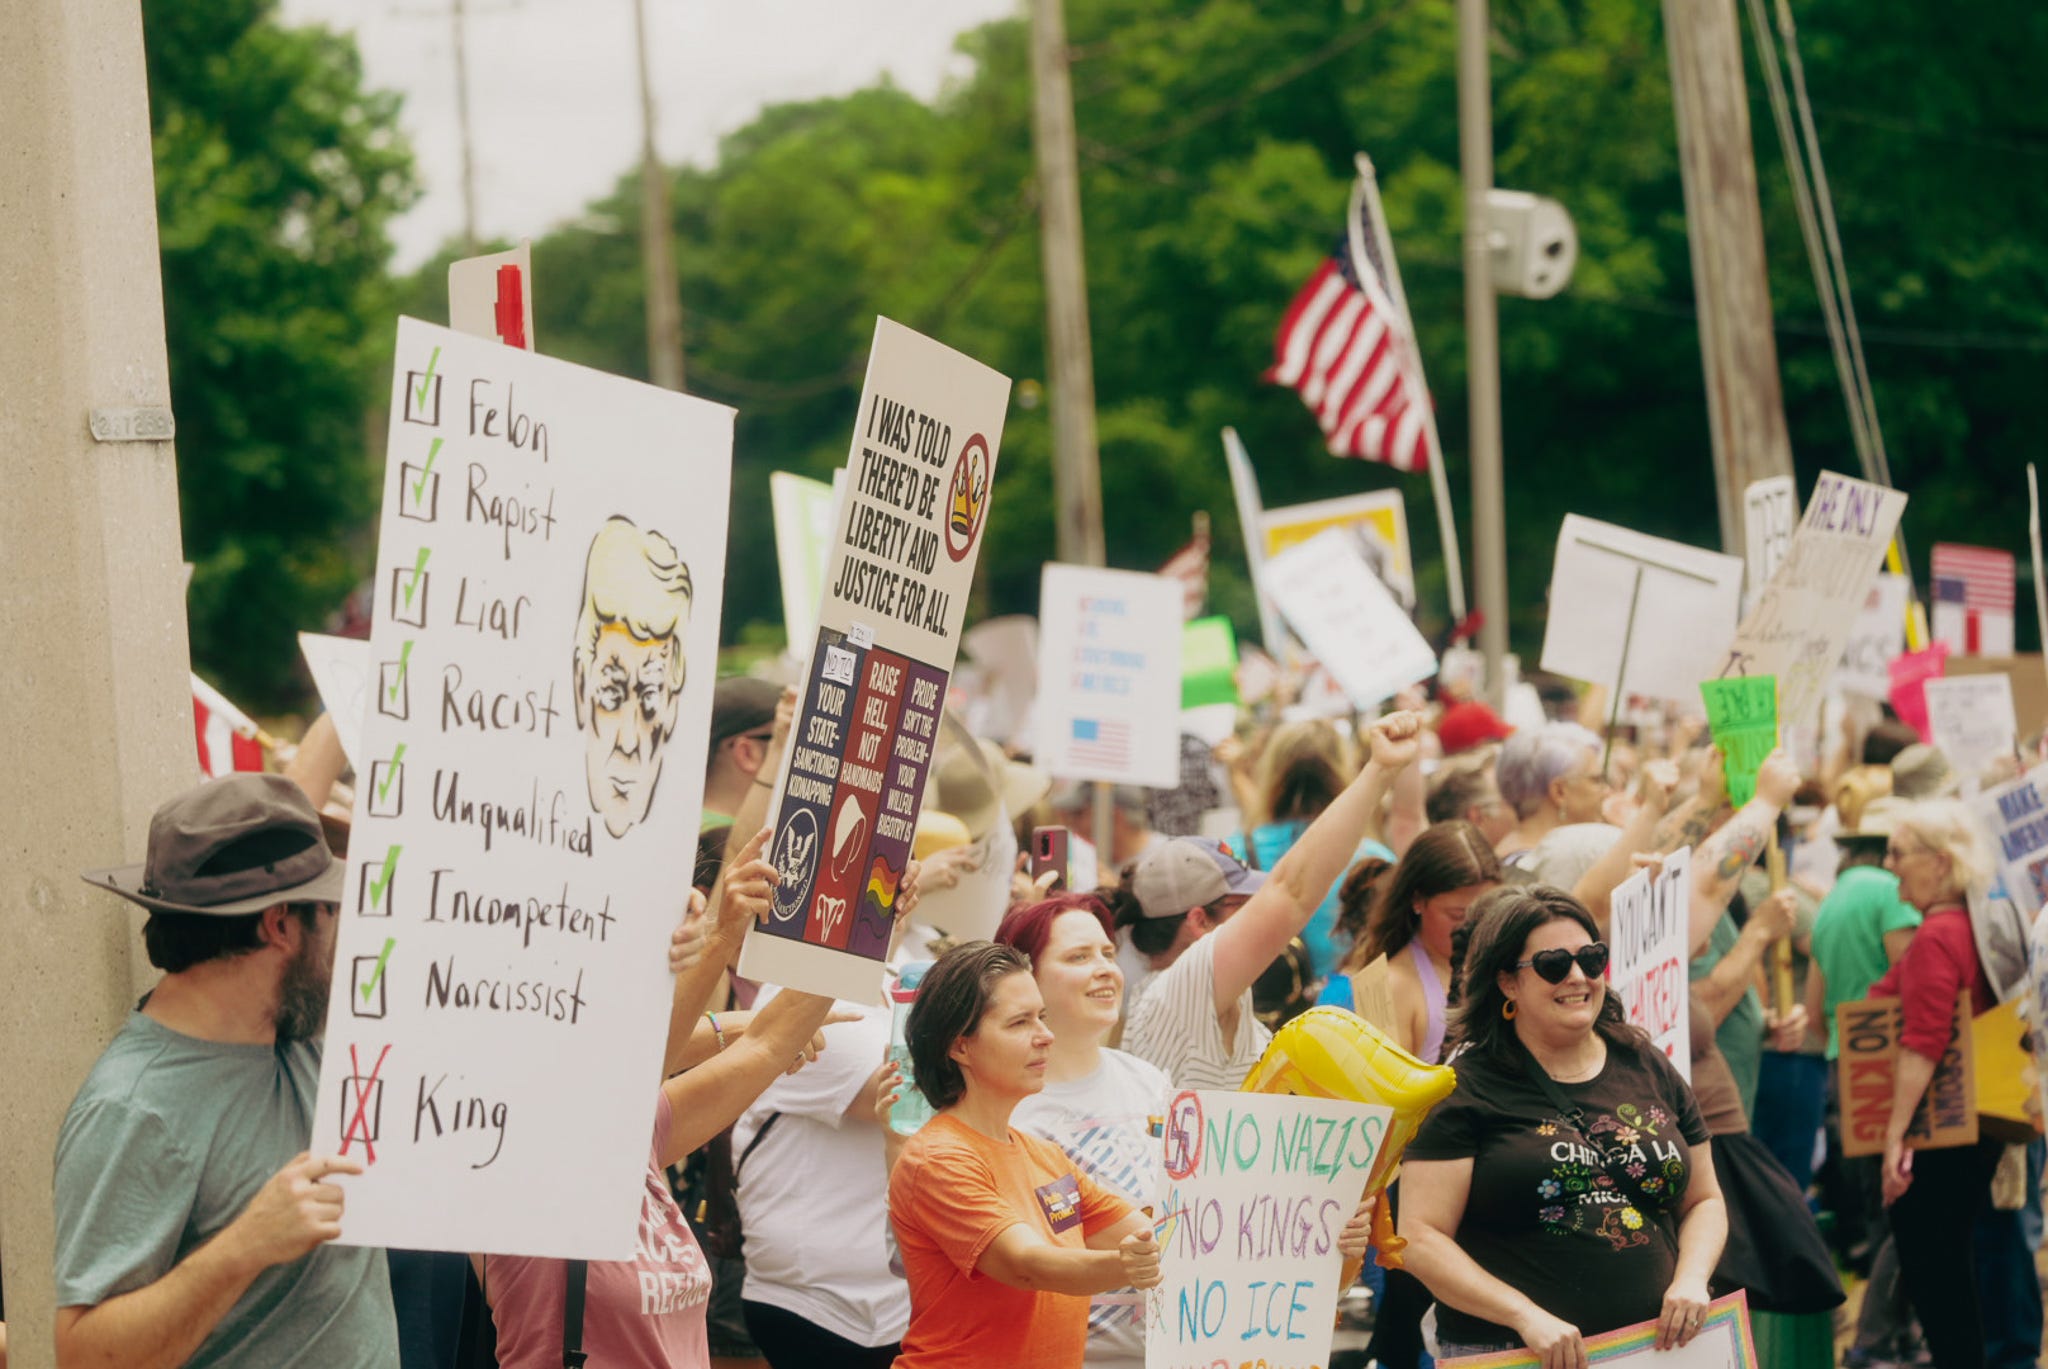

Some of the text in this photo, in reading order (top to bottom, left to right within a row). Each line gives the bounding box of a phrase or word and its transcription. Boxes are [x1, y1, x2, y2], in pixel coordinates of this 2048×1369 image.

[469, 378, 549, 462] Felon
[866, 394, 951, 469] I WAS TOLD
[466, 463, 557, 560] Rapist
[857, 447, 940, 521] THERE'D BE
[845, 501, 939, 576] LIBERTY AND
[455, 577, 530, 639] Liar
[833, 555, 950, 638] JUSTICE FOR ALL.
[441, 663, 560, 738] Racist
[817, 682, 846, 717] YOUR
[868, 661, 901, 697] RAISE
[911, 677, 939, 711] PRIDE
[807, 716, 840, 748] STATE-
[863, 696, 888, 735] HELL,
[902, 709, 934, 738] ISN'T THE
[793, 746, 840, 779] SANCTIONED
[839, 761, 884, 794] HANDMAIDS
[858, 732, 882, 764] NOT
[897, 764, 917, 789] YOUR
[433, 769, 593, 858] Unqualified
[787, 774, 834, 806] KIDNAPPING
[876, 813, 906, 841] BIGOTRY
[423, 868, 616, 948] Incompetent
[426, 954, 586, 1024] Narcissist
[1847, 1010, 1889, 1053] NO
[413, 1073, 508, 1169] King
[1204, 1108, 1261, 1177] NO
[1272, 1111, 1384, 1184] NAZIS
[1652, 1140, 1682, 1162] LA
[1180, 1192, 1341, 1261] NO KINGS
[1178, 1277, 1314, 1344] NO ICE
